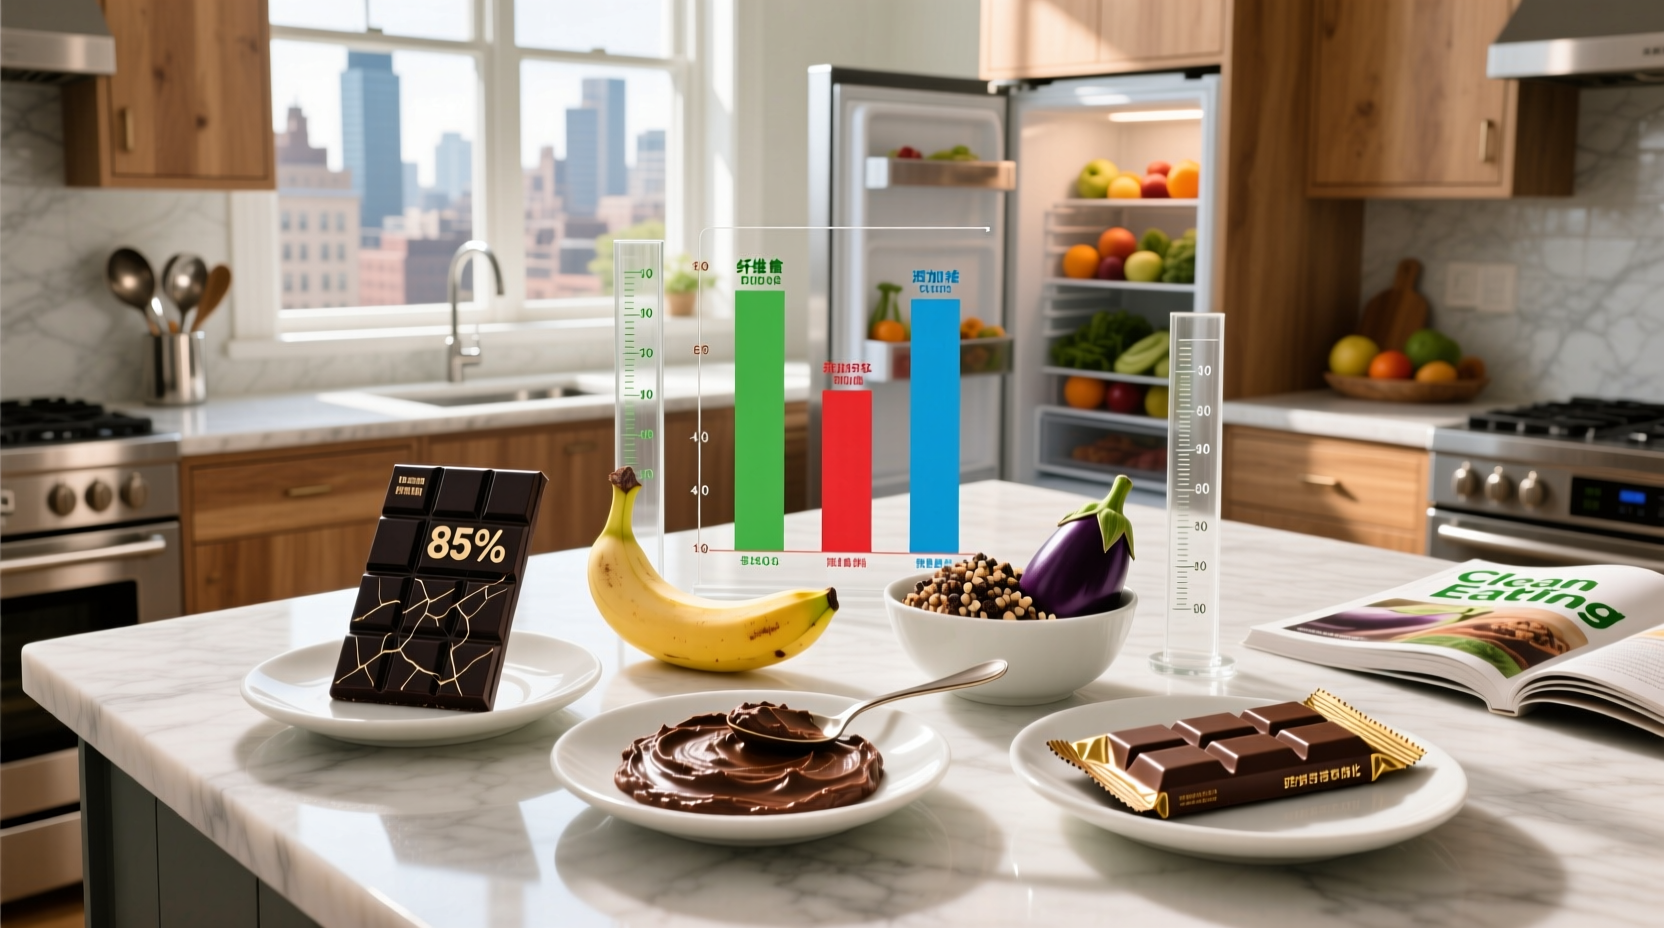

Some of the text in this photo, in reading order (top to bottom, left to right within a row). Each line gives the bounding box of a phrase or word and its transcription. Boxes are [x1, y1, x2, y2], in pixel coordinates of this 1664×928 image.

[427, 525, 505, 564] 85%
[1457, 570, 1598, 592] Clean
[1429, 583, 1626, 629] Eating
